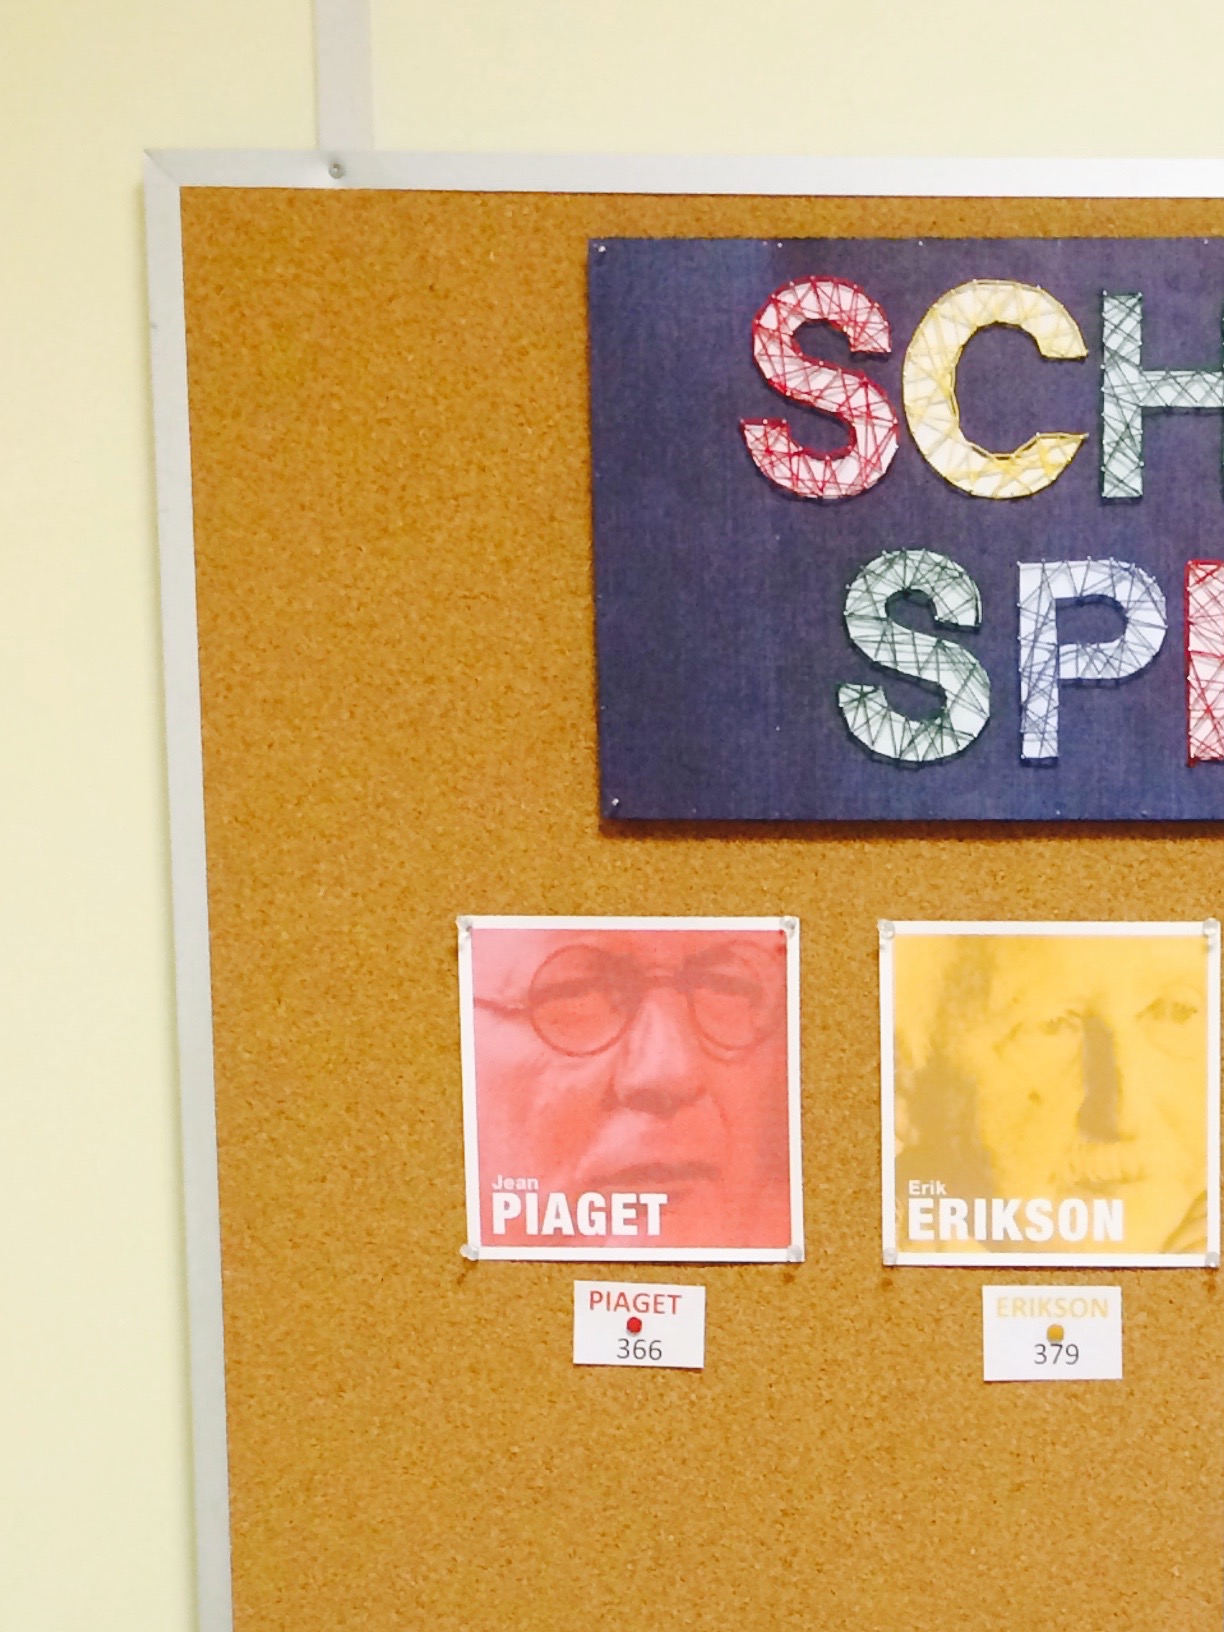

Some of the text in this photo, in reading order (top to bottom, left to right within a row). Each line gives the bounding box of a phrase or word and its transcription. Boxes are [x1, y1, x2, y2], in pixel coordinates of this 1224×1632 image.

[491, 1174, 540, 1191] Jean
[907, 1179, 948, 1196] Erik
[491, 1192, 669, 1238] PIAGET
[907, 1196, 1126, 1243] ERIKSON
[588, 1289, 683, 1316] PIAGET
[995, 1294, 1109, 1320] ERIKSON
[616, 1337, 664, 1362] 366
[1032, 1342, 1080, 1367] 379
